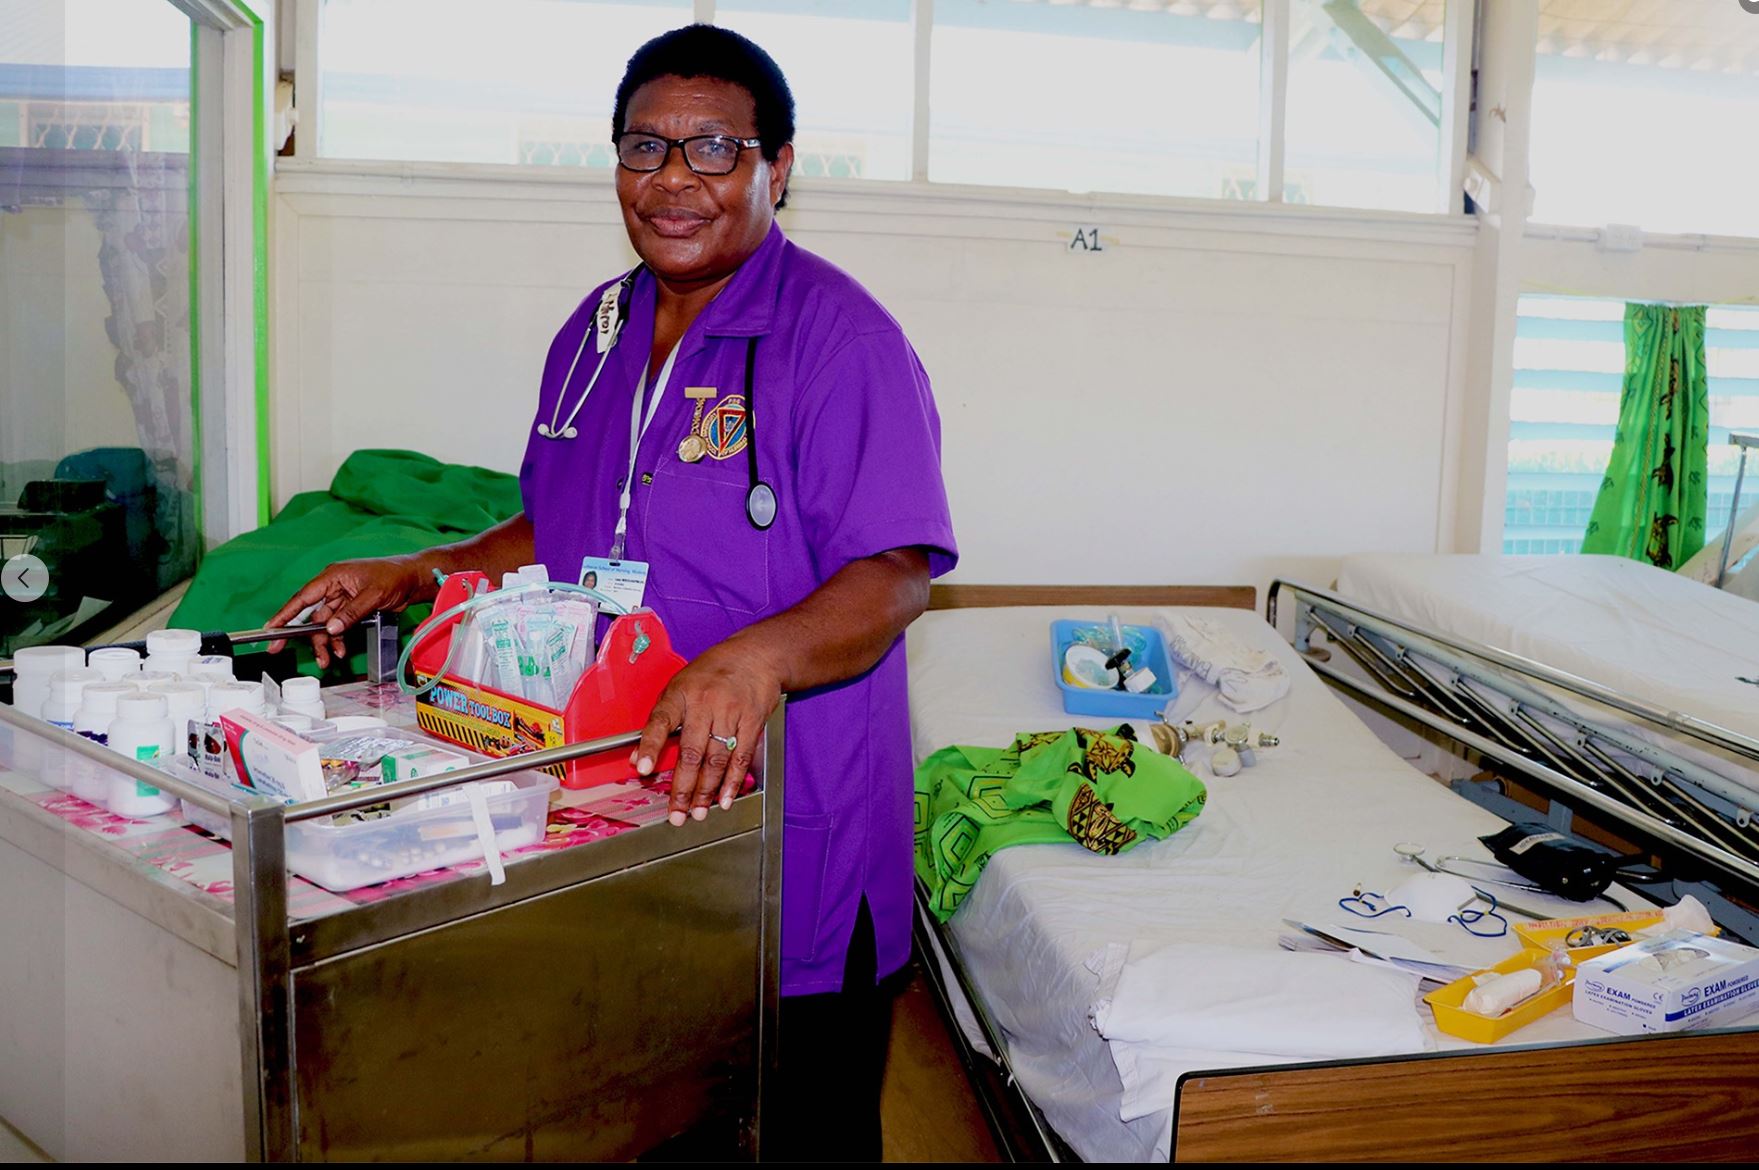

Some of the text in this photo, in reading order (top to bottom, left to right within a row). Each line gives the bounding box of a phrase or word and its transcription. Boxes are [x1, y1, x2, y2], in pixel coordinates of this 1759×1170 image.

[1070, 227, 1102, 251] A1
[429, 686, 469, 714] POWER
[1606, 987, 1631, 1000] EXAM
[1704, 980, 1727, 997] EXAM
[1600, 995, 1633, 1009] EXAMINATION
[1683, 1002, 1703, 1017] LATEX
[1702, 989, 1740, 1008] EXAMINATION
